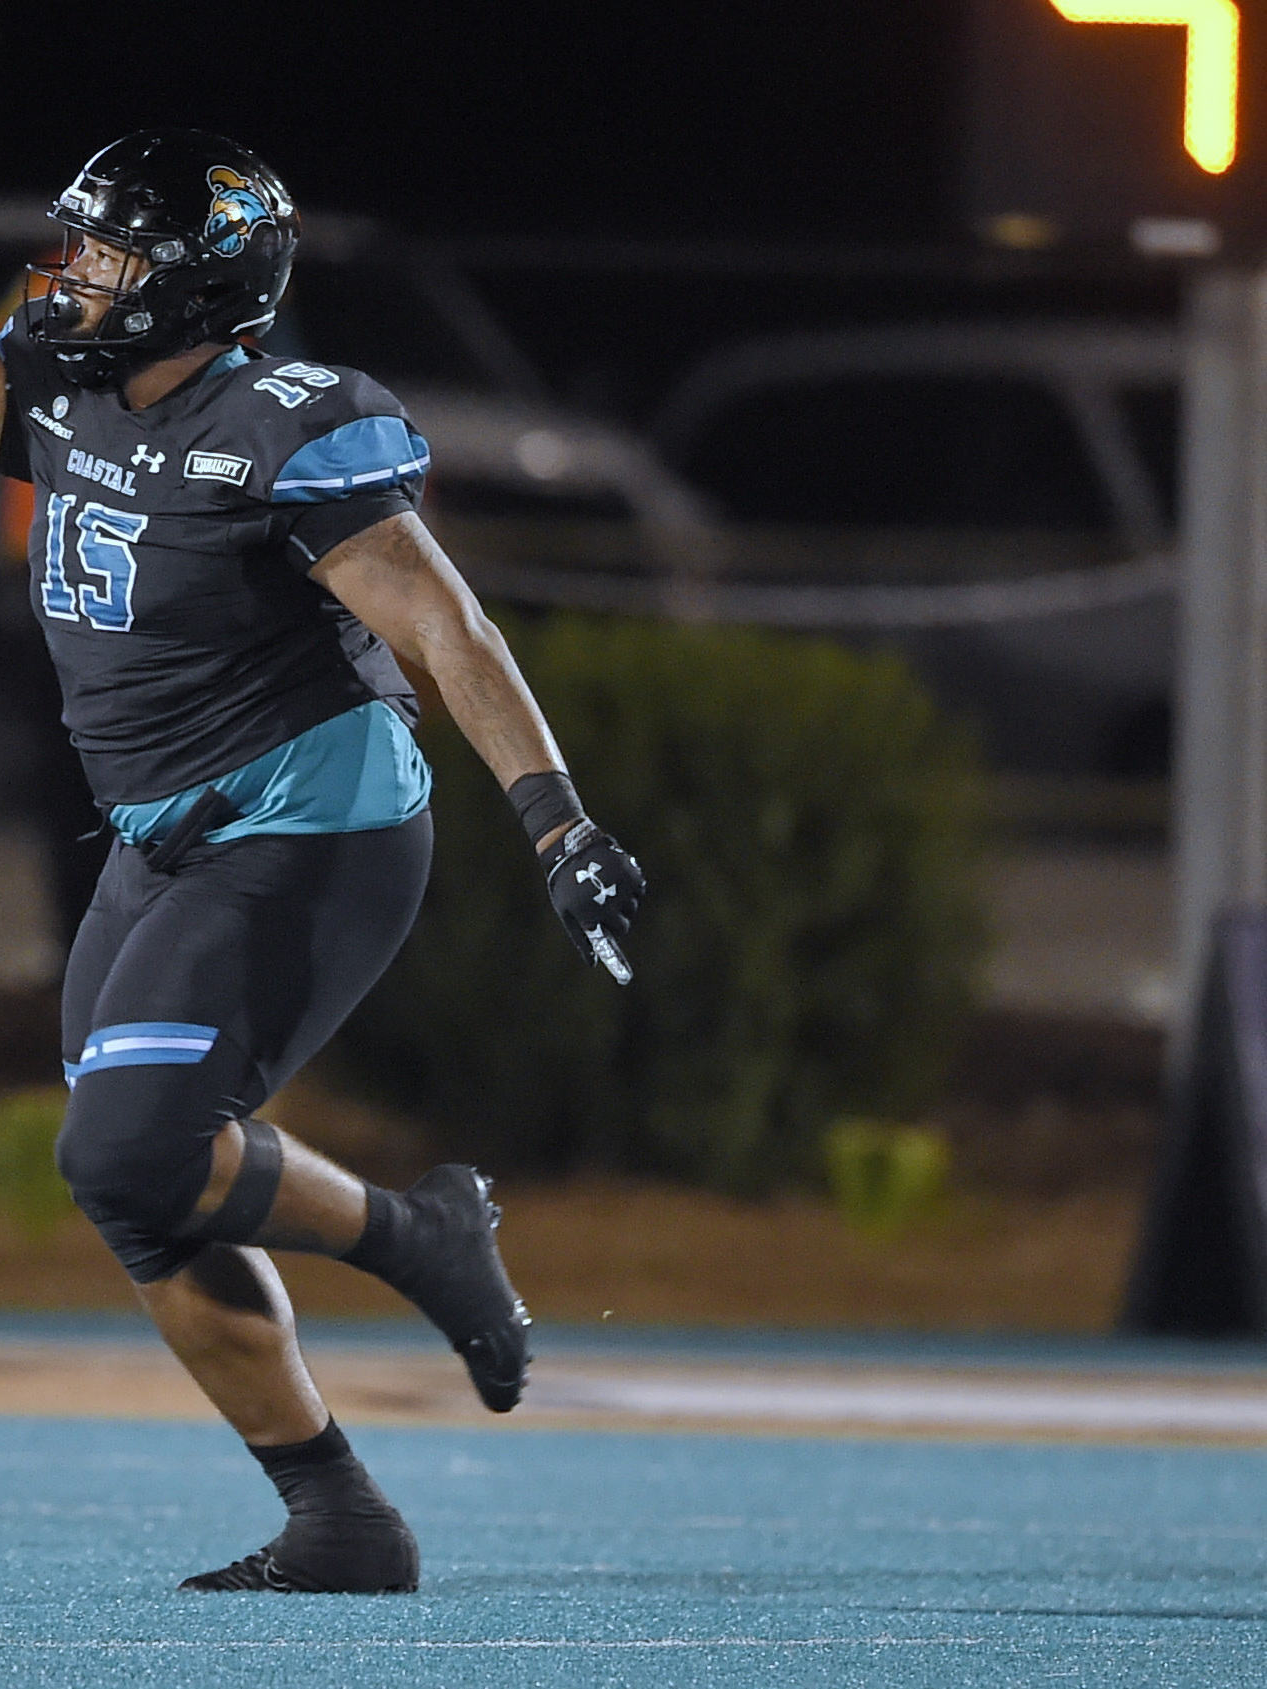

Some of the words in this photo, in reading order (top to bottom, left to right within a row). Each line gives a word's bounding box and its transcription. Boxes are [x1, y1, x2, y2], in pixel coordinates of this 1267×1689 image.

[253, 362, 340, 409] 15
[66, 448, 137, 497] COASTAL
[40, 492, 149, 632] 15
